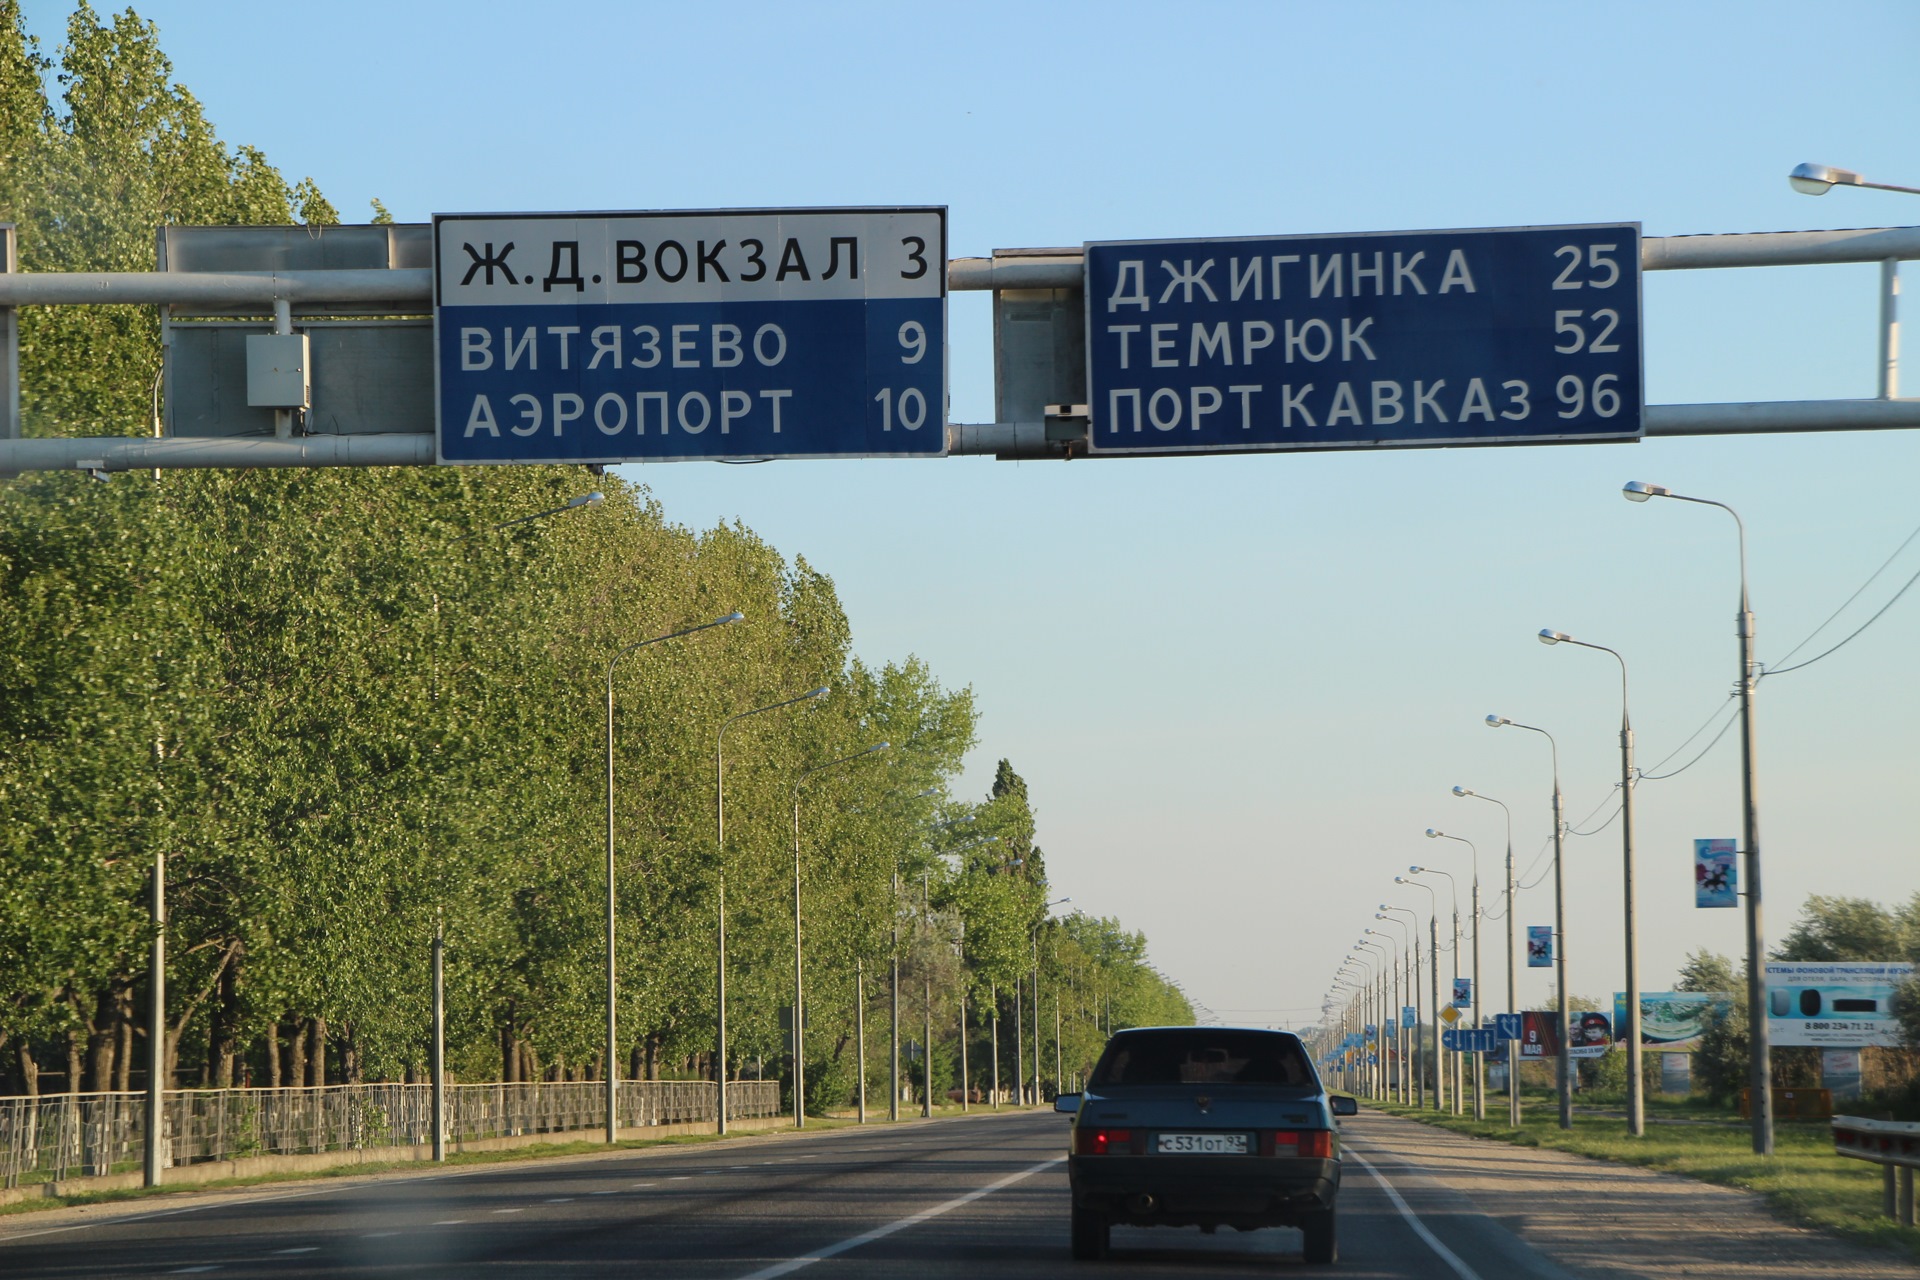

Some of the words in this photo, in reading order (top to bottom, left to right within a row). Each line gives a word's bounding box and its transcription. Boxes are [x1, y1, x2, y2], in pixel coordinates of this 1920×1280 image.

[901, 235, 928, 280] 3
[1107, 249, 1476, 312] ДЖИГИНКА
[1551, 244, 1620, 290] 25
[461, 323, 787, 371] ВИТЯЗЕВО
[898, 320, 927, 365] 9
[1107, 316, 1377, 369] ТЕМРЮК
[1553, 308, 1621, 355] 52
[463, 389, 793, 438] АЭРОПОРТ
[874, 387, 927, 431] 10
[1108, 384, 1263, 433] ПОРТ
[1282, 377, 1532, 428] КАВКАЗ
[1555, 373, 1621, 419] 96
[1796, 966, 1835, 974] ФОНОВОЙ
[1523, 1044, 1543, 1055] МАЯ
[1529, 1030, 1537, 1043] 9
[1805, 1022, 1811, 1030] 8
[1813, 1022, 1830, 1030] 800
[1851, 1022, 1861, 1030] 71
[1864, 1022, 1875, 1030] 21
